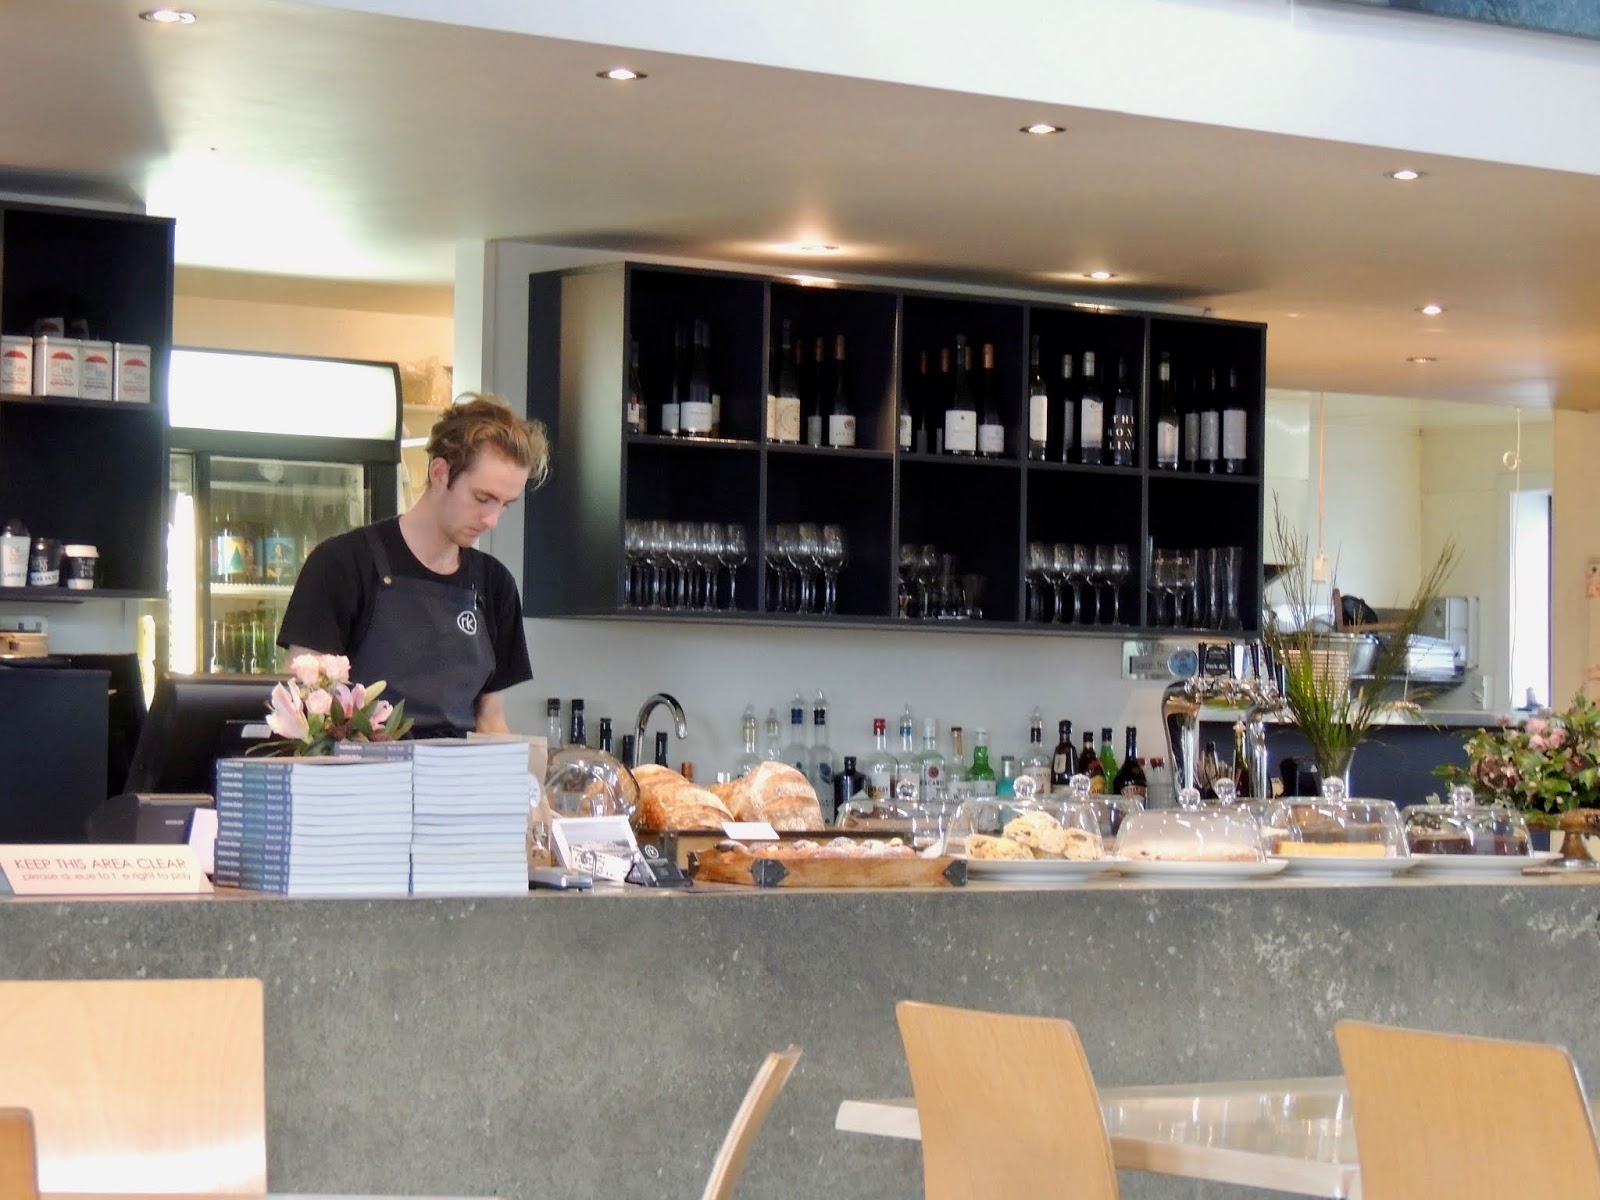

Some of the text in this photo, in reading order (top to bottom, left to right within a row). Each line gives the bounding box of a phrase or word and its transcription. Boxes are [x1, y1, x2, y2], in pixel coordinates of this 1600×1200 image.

[14, 857, 187, 870] KEEP THIS AREA CLEAR
[22, 873, 58, 881] please
